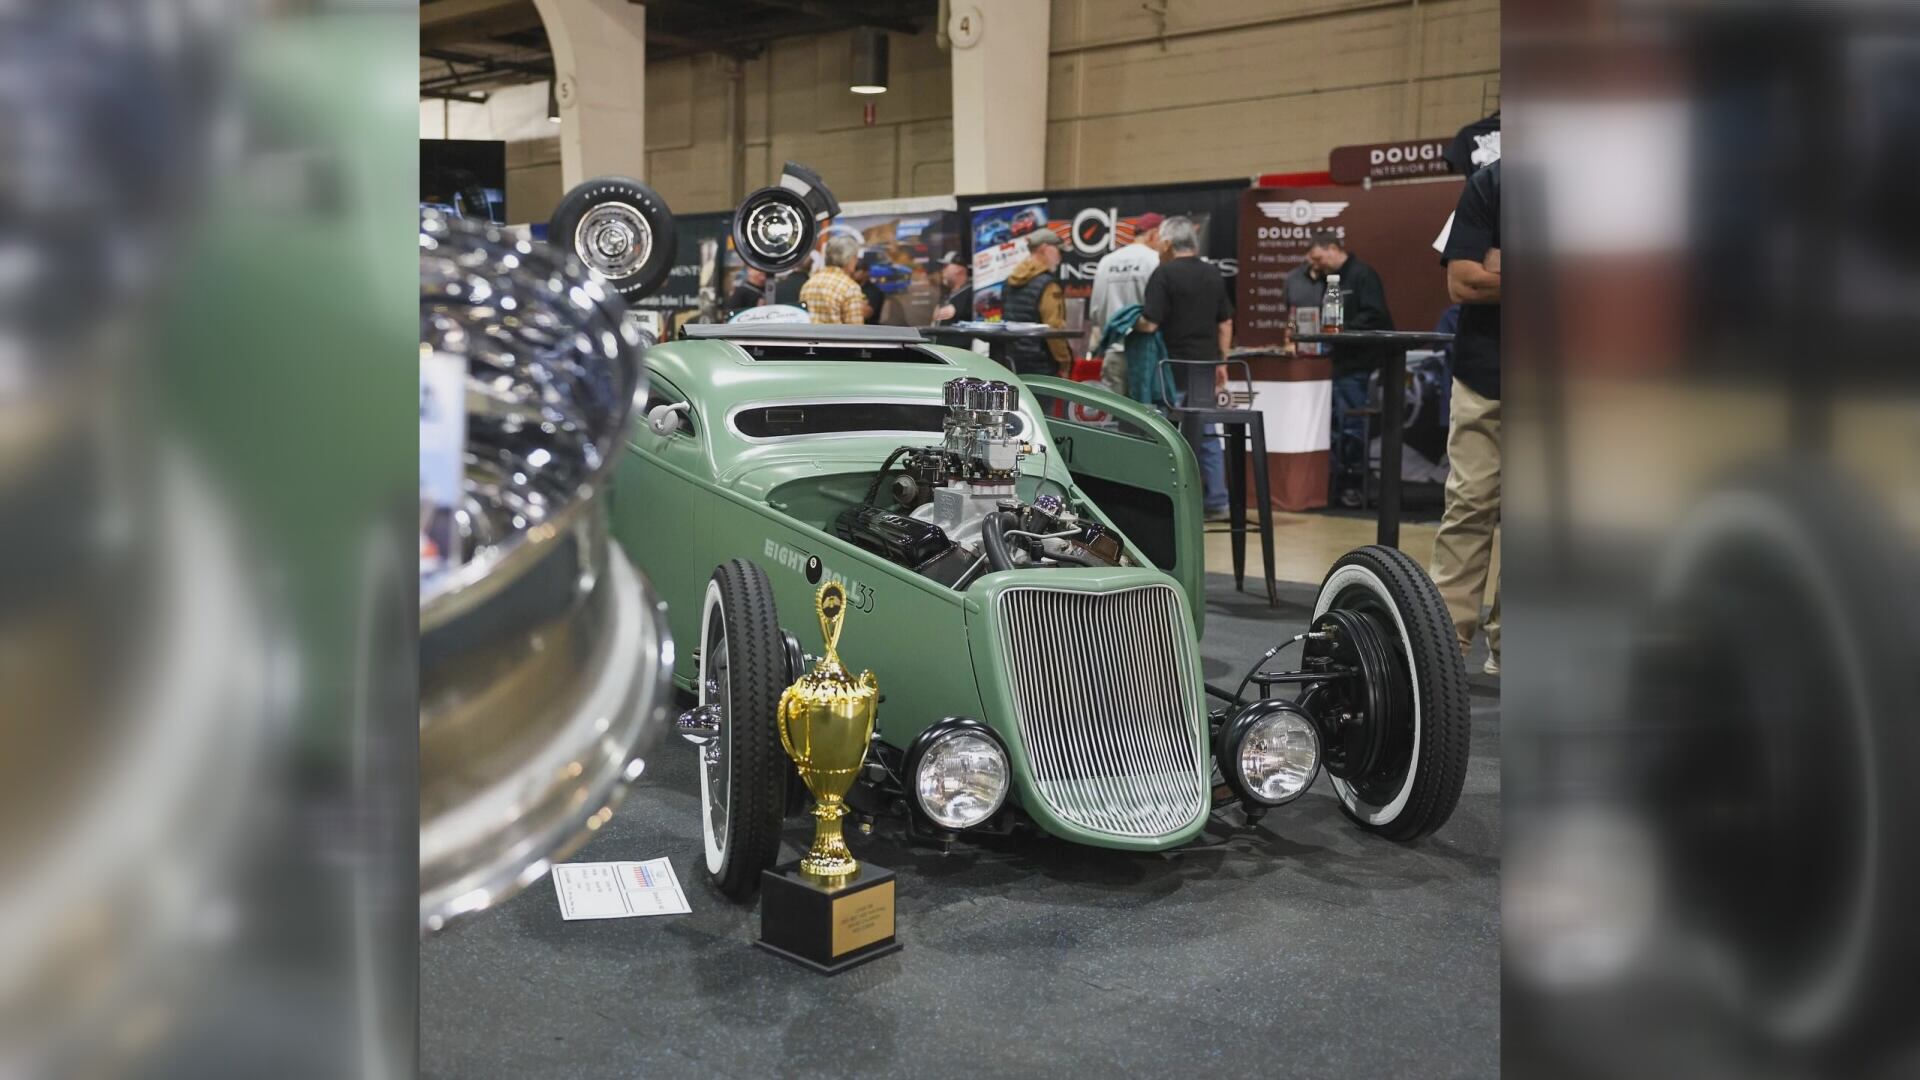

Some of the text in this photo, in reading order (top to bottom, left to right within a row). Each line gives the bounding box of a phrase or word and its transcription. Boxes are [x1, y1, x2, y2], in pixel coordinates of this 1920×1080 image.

[960, 16, 970, 36] 4
[562, 82, 569, 99] 5
[764, 538, 807, 574] EIGHT
